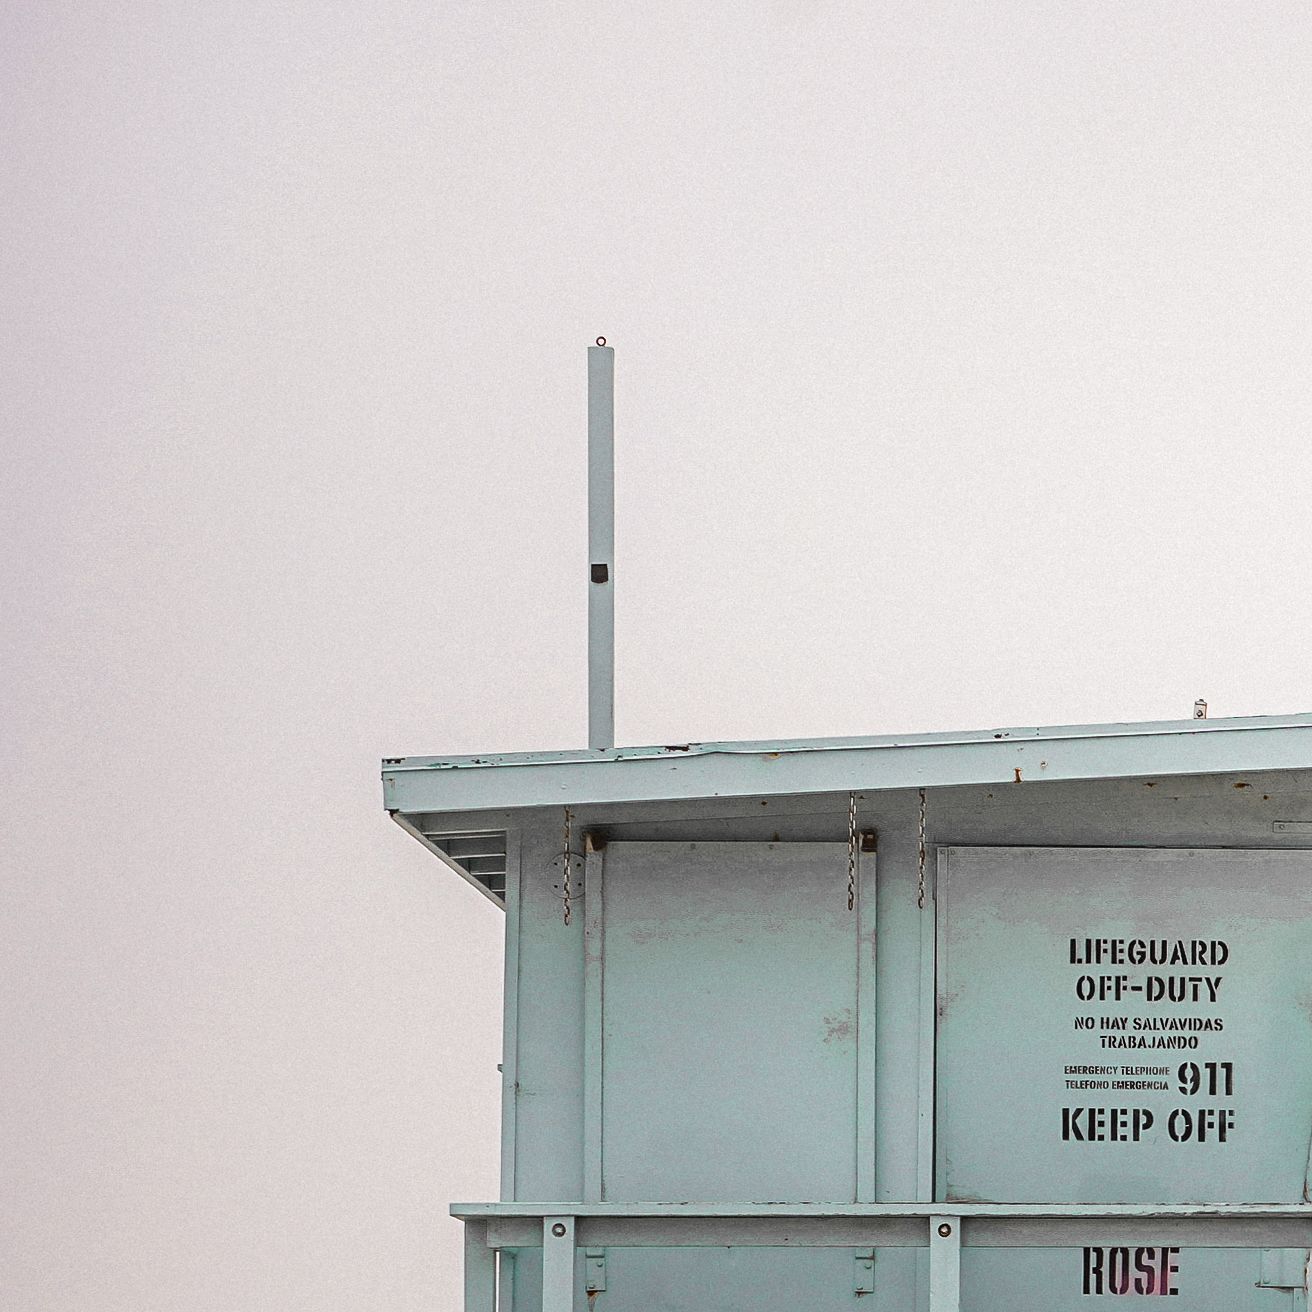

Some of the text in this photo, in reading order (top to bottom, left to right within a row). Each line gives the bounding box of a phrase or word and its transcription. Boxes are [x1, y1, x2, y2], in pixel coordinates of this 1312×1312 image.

[1069, 938, 1229, 966] LIFEGUARD
[1076, 975, 1223, 1003] OFF-DUTY
[1074, 1016, 1224, 1032] NO HAY SALVAVIDAS
[1099, 1035, 1199, 1050] TRABAJANDO
[1064, 1065, 1170, 1076] EMERGENCY TELEPHONE
[1177, 1061, 1234, 1096] 911
[1065, 1080, 1169, 1090] TELEFONO EMERGENCIA
[1061, 1107, 1235, 1143] KEEP OFF
[1082, 1247, 1180, 1296] ROSE
